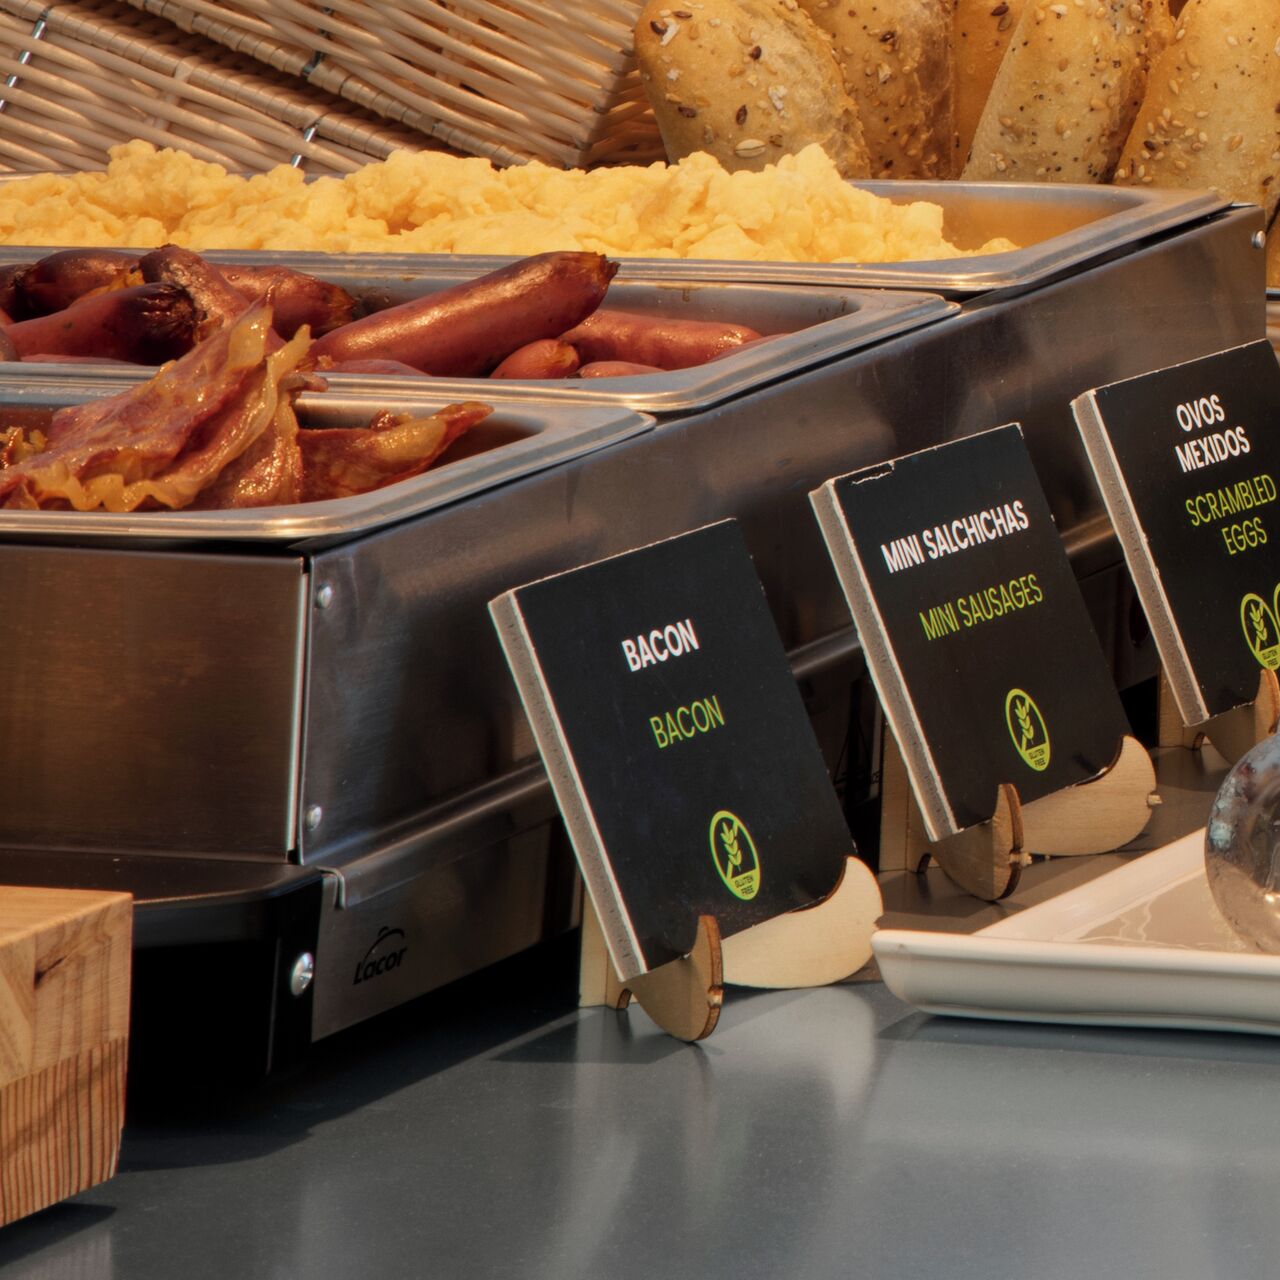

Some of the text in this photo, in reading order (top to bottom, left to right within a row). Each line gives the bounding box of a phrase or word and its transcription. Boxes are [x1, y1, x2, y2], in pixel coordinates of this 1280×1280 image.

[1176, 394, 1225, 432] OVOS
[1174, 425, 1251, 473] MEXIDOS
[1185, 474, 1278, 527] SCRAMBLED
[880, 499, 1029, 574] MINI SALCHICHAS
[1222, 516, 1268, 556] EGGS
[919, 573, 1044, 642] MINI SAUSAGES
[621, 618, 699, 672] BACON
[649, 694, 725, 749] BACON
[352, 946, 408, 986] Lacor
